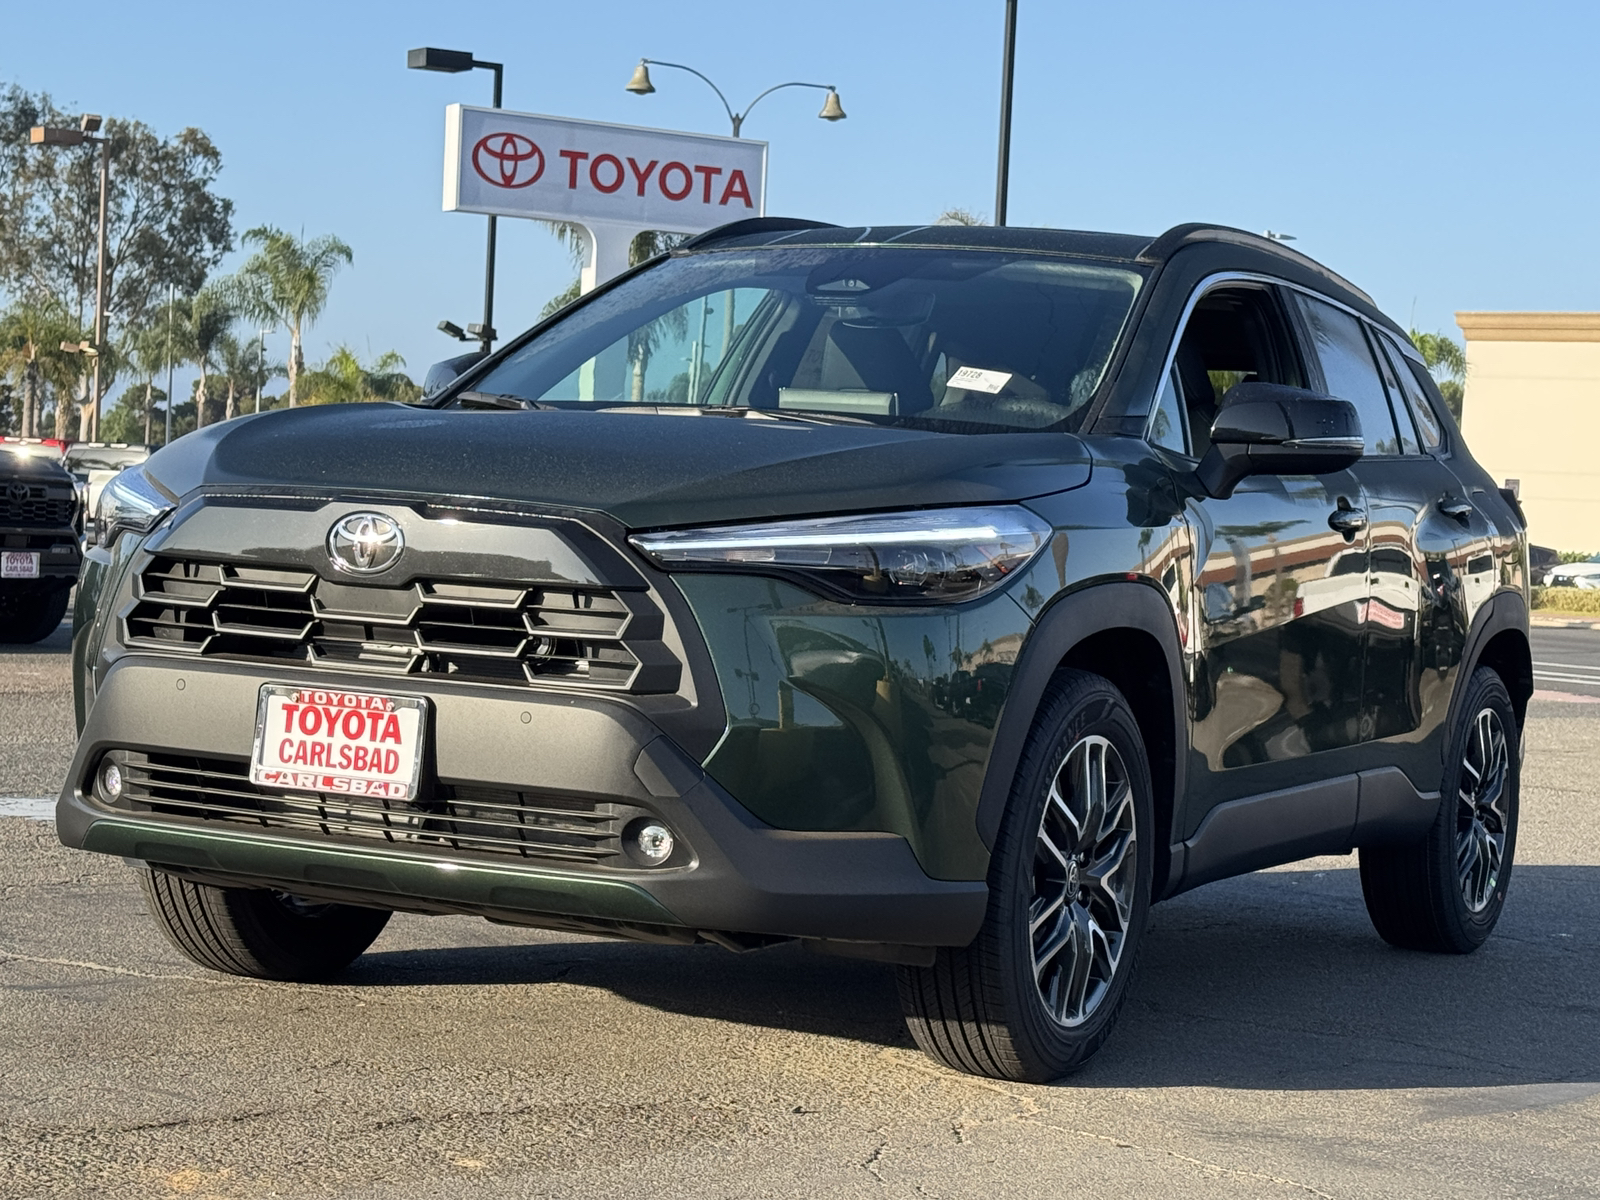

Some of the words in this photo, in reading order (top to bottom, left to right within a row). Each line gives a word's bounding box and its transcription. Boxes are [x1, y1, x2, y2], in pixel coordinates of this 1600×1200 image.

[559, 149, 754, 209] TOYOTA
[301, 690, 385, 711] TOYOTA
[282, 703, 402, 745] TOYOTA
[278, 737, 400, 775] CARLSBAD
[258, 769, 408, 798] CARLSBAD
